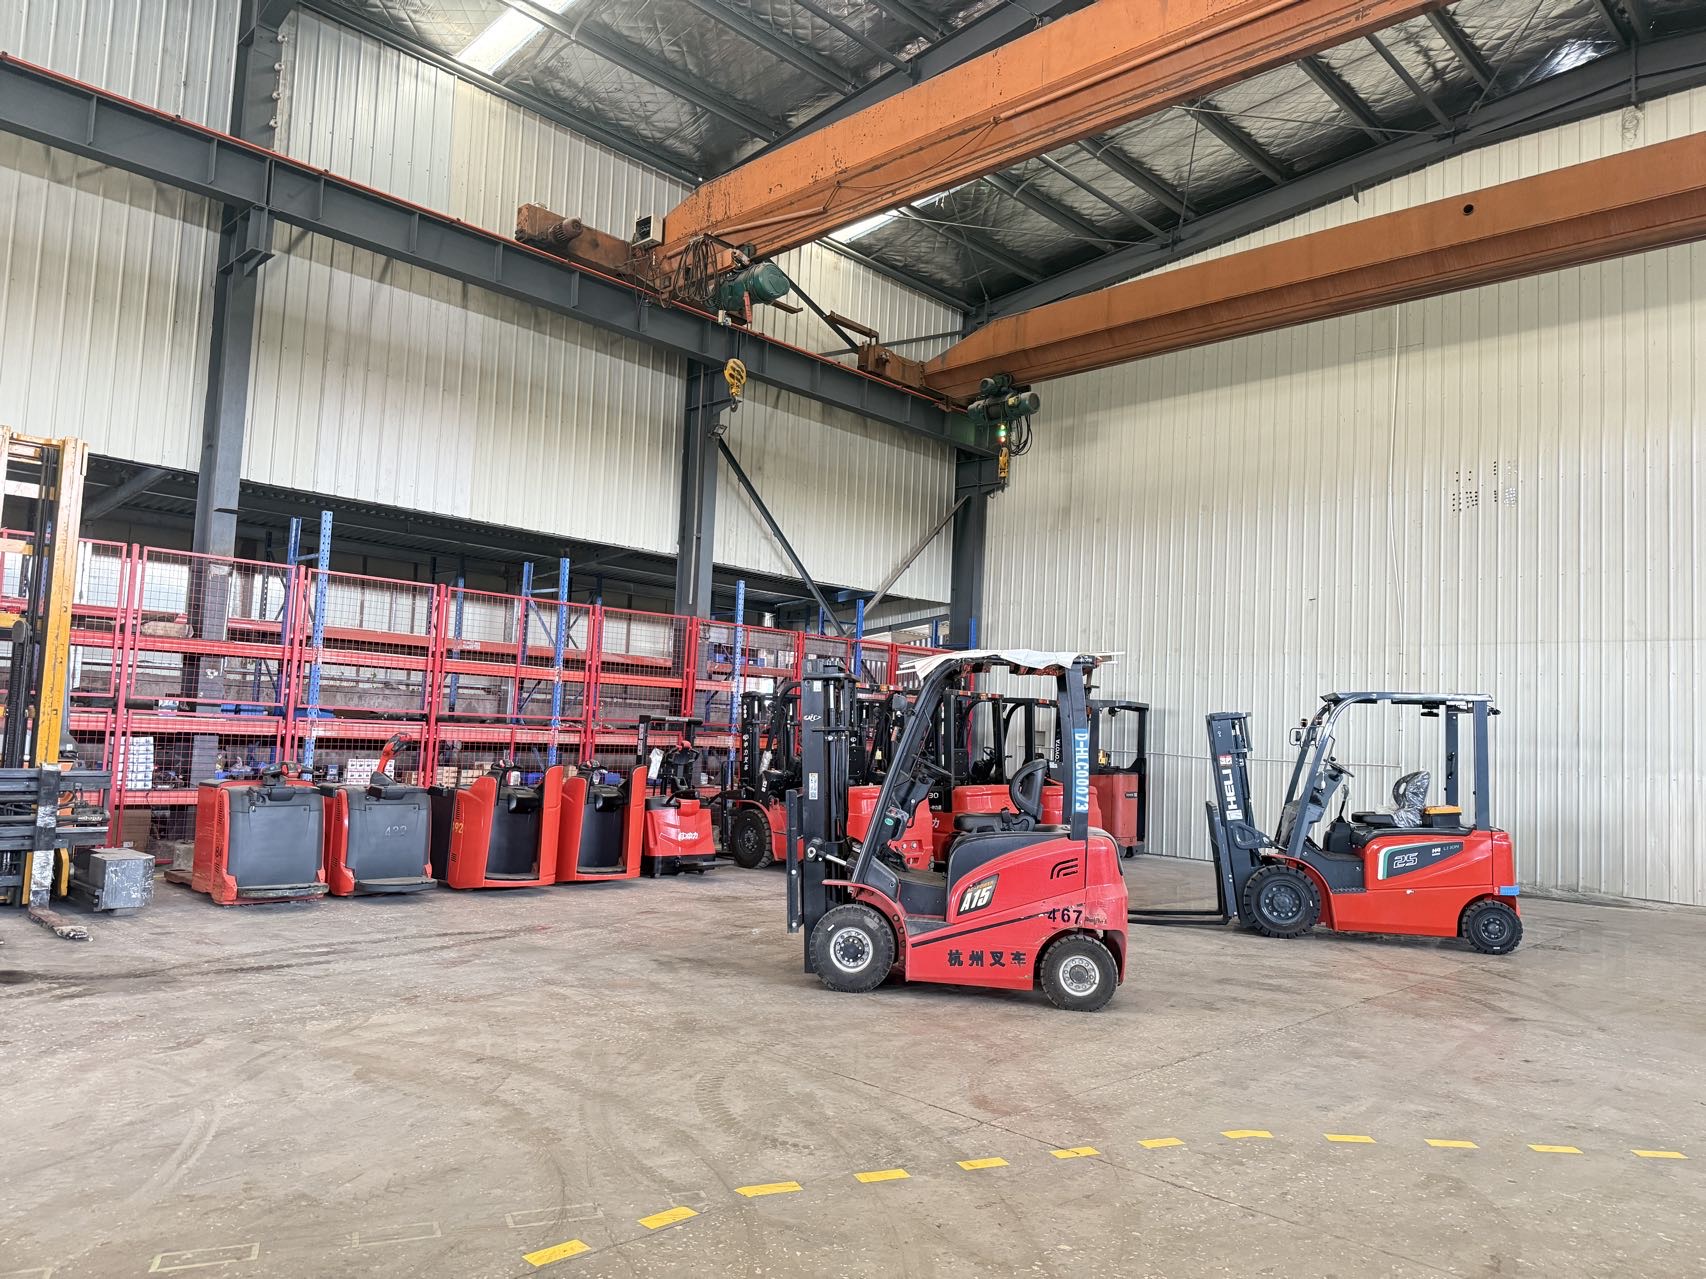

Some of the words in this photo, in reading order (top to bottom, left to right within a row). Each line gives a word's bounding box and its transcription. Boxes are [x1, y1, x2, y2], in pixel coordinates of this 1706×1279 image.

[1075, 733, 1089, 811] D-HLC00073
[1221, 768, 1238, 810] HELI
[1393, 852, 1419, 869] 25
[959, 885, 993, 912] A15
[1047, 907, 1083, 925] 467
[947, 950, 1027, 967] 杭州叉车
